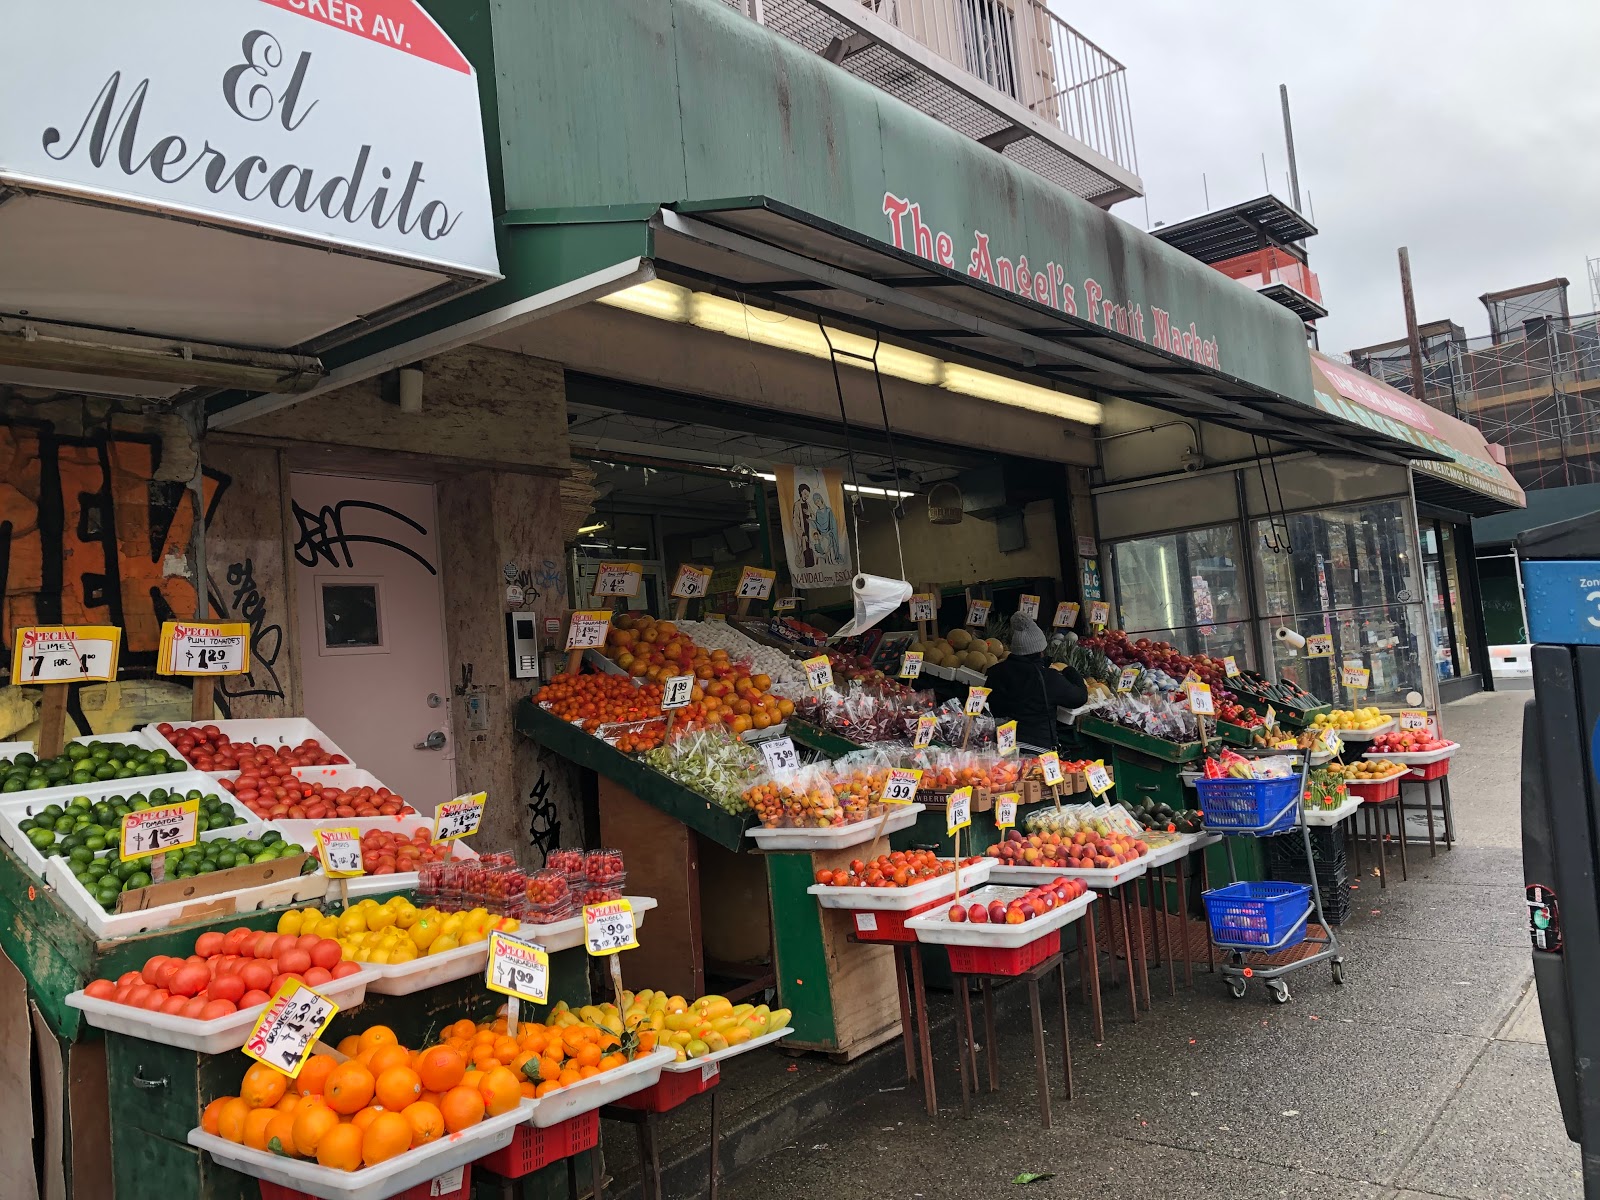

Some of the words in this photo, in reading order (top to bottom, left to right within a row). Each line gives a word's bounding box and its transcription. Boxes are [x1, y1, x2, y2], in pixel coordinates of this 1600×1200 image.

[284, 0, 365, 32] CKER
[372, 14, 412, 49] AV.
[222, 29, 319, 132] El
[42, 70, 464, 241] Mercadito
[883, 192, 954, 270] The
[968, 230, 1078, 317] Angel's
[1084, 278, 1146, 343] Fruit
[1151, 305, 1221, 371] Market
[1314, 389, 1417, 446] MARKET
[1380, 394, 1418, 422] MARKET
[1411, 459, 1432, 471] UCTOS
[1432, 461, 1464, 482] MEXICANOS
[1469, 475, 1491, 493] HISPANOS
[1498, 487, 1516, 500] GENERAL
[792, 571, 823, 584] NAVIDAD
[1580, 579, 1600, 588] Zon
[22, 631, 78, 648] SPECIAL
[173, 625, 222, 641] SPECIAL
[210, 637, 241, 646] TOMATOES
[38, 642, 75, 651] LIMES
[28, 655, 46, 677] 7
[54, 658, 72, 668] FOR
[125, 807, 187, 829] SPECIAL
[139, 817, 184, 829] TOMATOES
[320, 831, 356, 847] SPECIAL
[440, 826, 451, 840] 2
[585, 905, 623, 924] SPECIAL
[496, 940, 538, 962] SPECIAL
[589, 939, 602, 951] 3
[247, 995, 291, 1057] SPECIAL
[267, 1002, 298, 1045] ORANGES
[281, 1048, 304, 1067] 4
